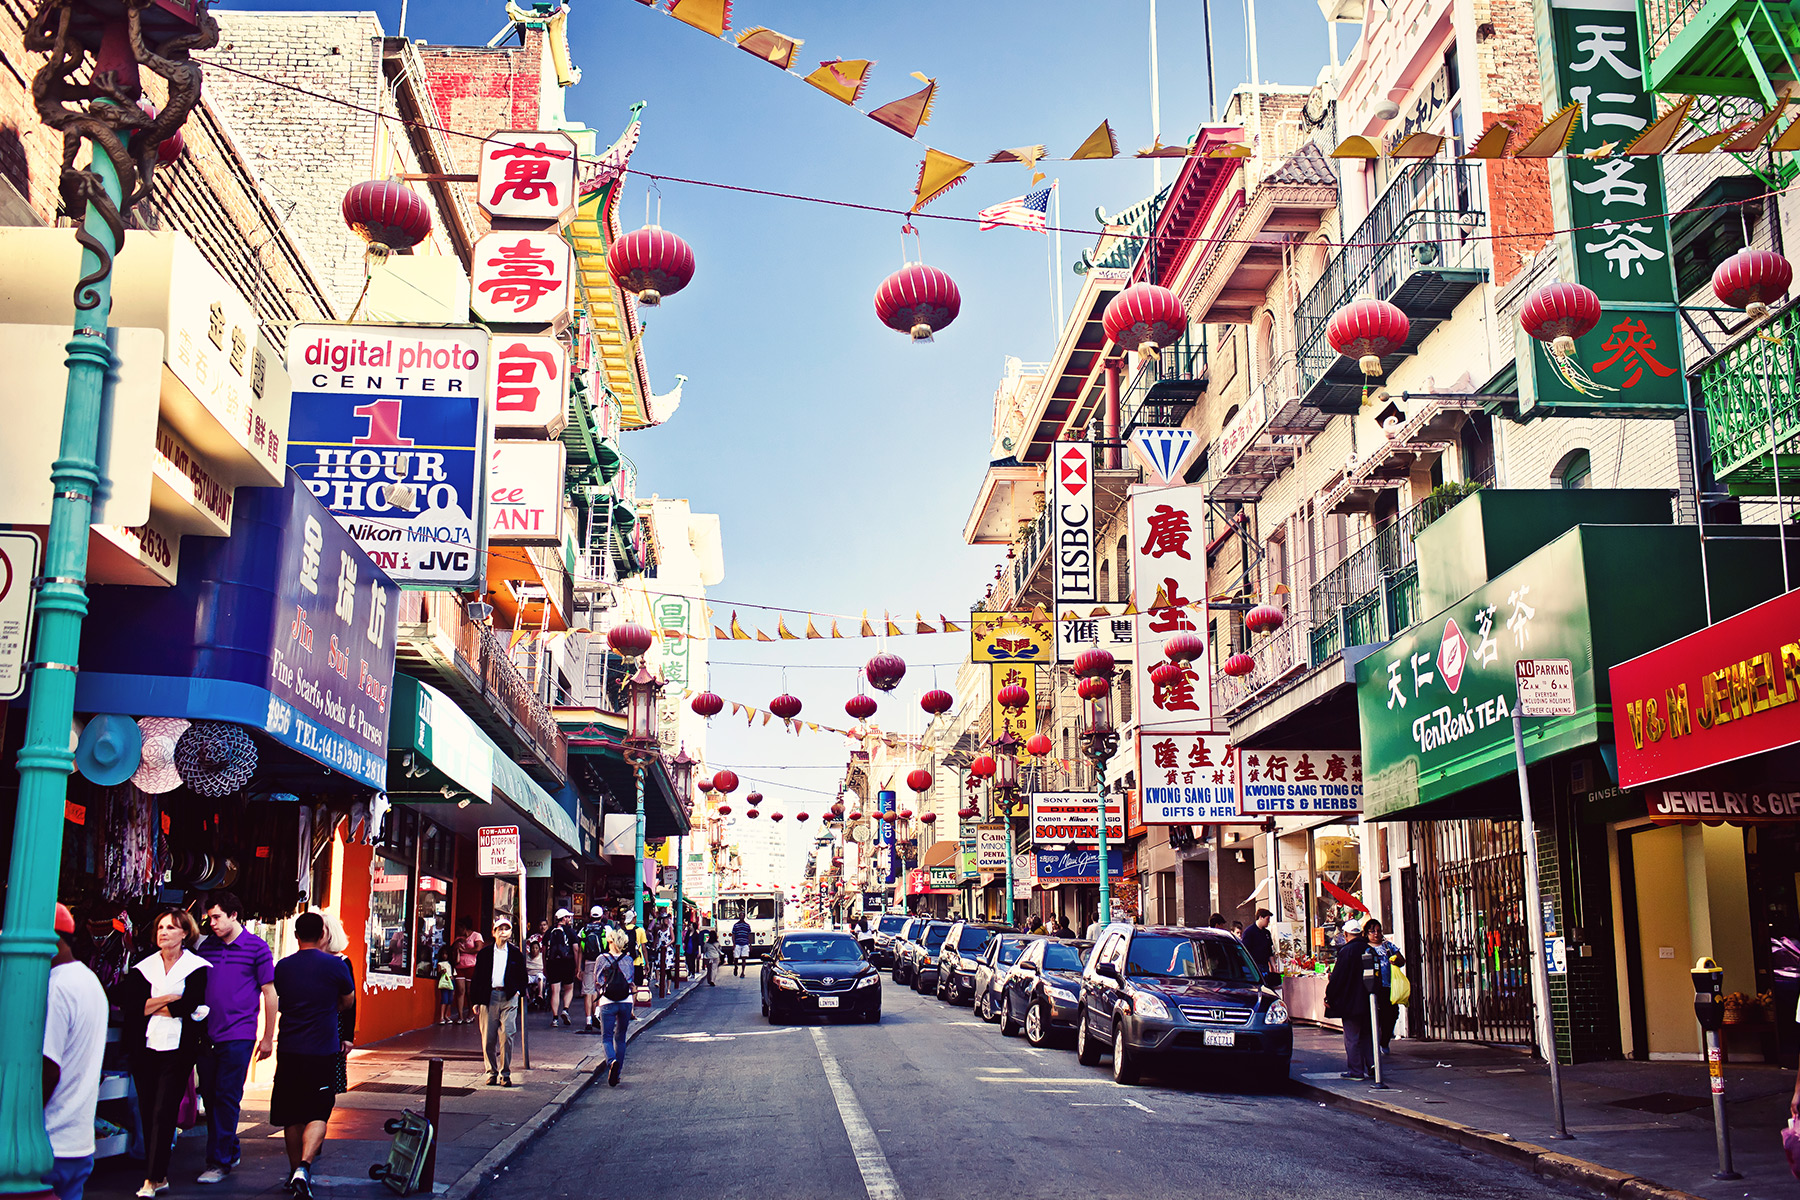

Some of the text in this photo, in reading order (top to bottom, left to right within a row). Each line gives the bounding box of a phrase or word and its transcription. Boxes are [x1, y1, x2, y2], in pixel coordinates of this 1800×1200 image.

[1569, 24, 1665, 279] 天仁茗茶
[305, 338, 479, 373] digital photo
[1593, 316, 1678, 389] 參
[312, 374, 463, 392] CENTER
[352, 399, 415, 448] 1
[313, 449, 448, 481] HOUR
[304, 479, 459, 512] PHOTO
[494, 509, 545, 530] ANT
[347, 523, 403, 543] Nikon
[1061, 504, 1090, 595] HSBC
[419, 551, 469, 571] JVC
[292, 605, 314, 653] Jin
[328, 633, 350, 680] Sui
[358, 658, 388, 714] Fang
[1518, 661, 1569, 676] NO PARKING
[1522, 679, 1529, 690] 2
[1551, 679, 1557, 690] 6
[1696, 640, 1800, 729] JEWELR
[271, 648, 294, 689] Fine
[324, 689, 347, 725] Socks
[349, 704, 357, 730] &
[357, 709, 384, 748] Purses
[1476, 694, 1509, 729] TEA
[1145, 786, 1235, 804] KWONG SANG LUN
[1245, 784, 1284, 797] KWONG
[1287, 784, 1316, 796] SANG
[1319, 784, 1349, 796] TONG
[1162, 807, 1194, 817] GIFTS
[1199, 807, 1206, 817] &
[1256, 798, 1357, 810] GIFTS & HERBS
[1657, 791, 1800, 815] JEWELRY & GIF
[480, 835, 516, 846] NO STOPPING
[981, 833, 1006, 841] Cano
[1036, 825, 1122, 838] SOUVENRS
[491, 847, 506, 855] ANY
